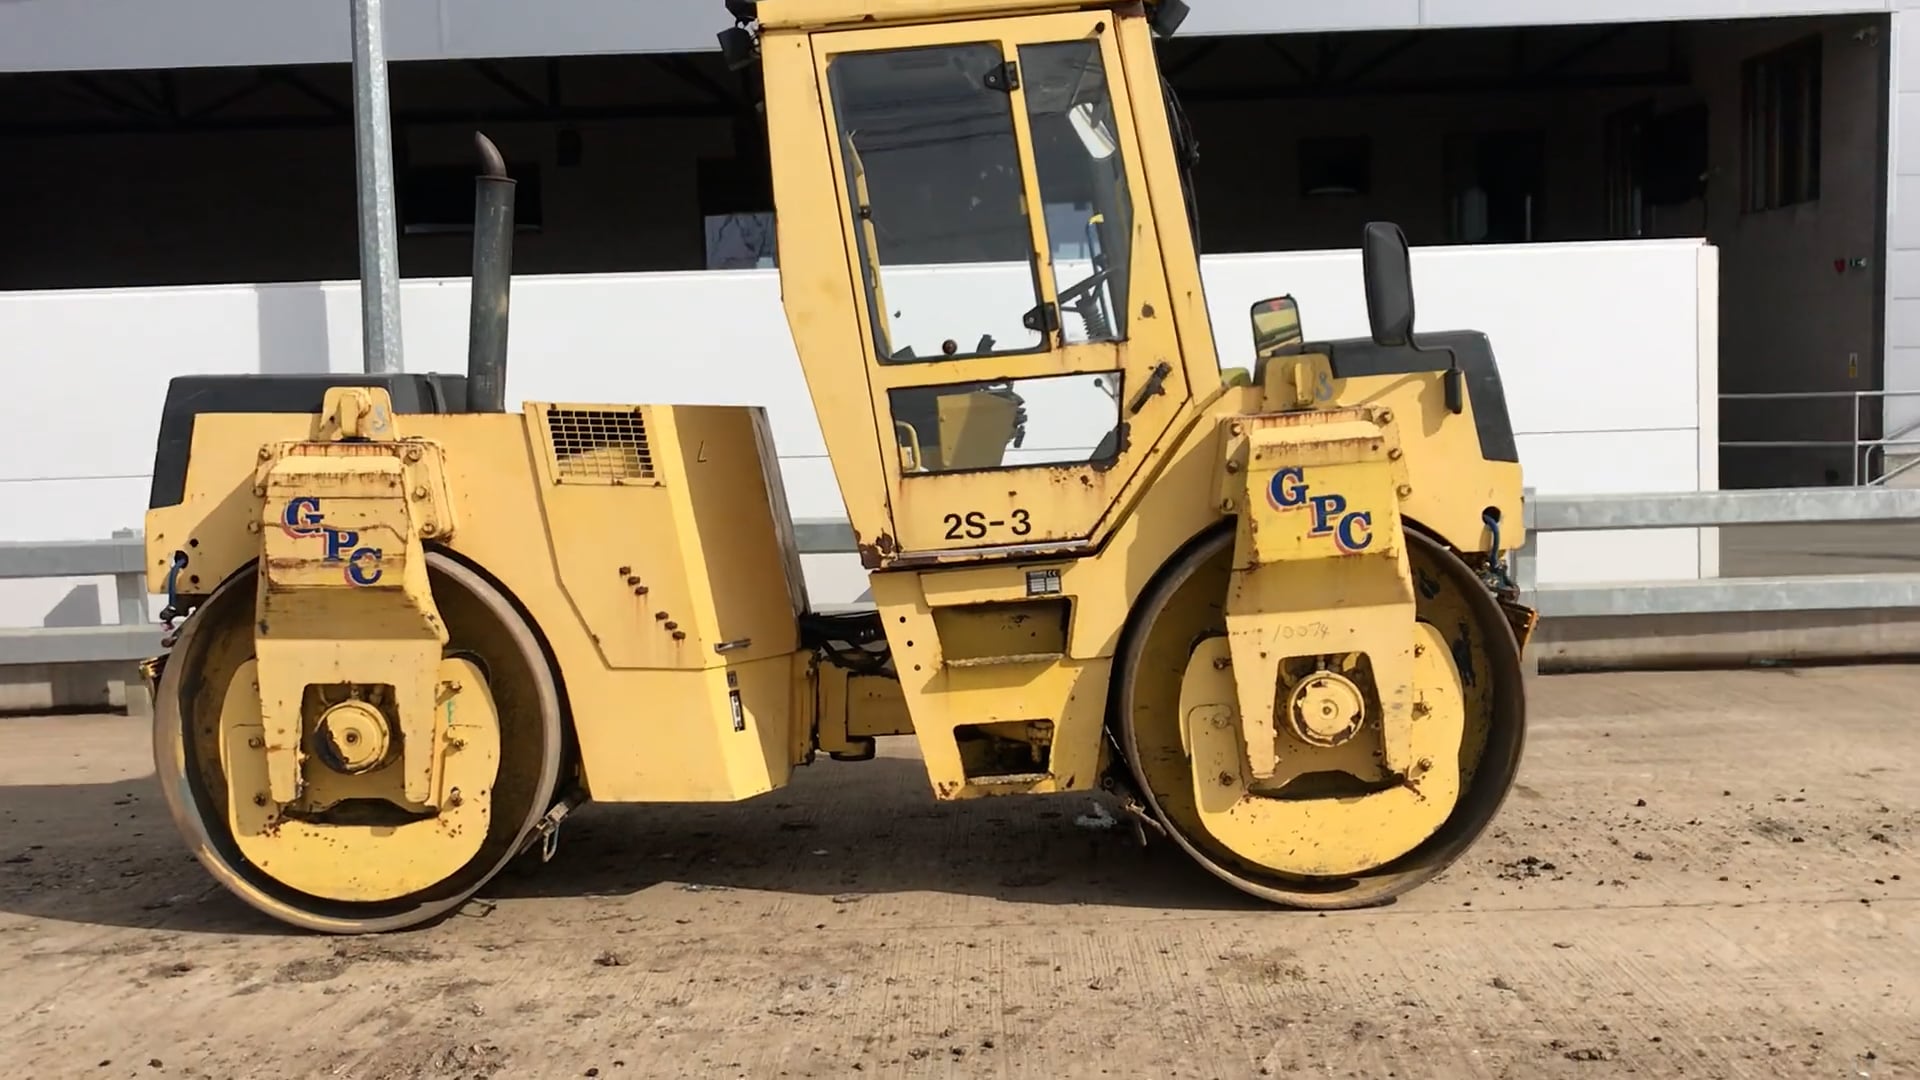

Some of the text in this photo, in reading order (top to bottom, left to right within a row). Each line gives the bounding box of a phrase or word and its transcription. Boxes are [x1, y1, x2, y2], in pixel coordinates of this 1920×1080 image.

[281, 496, 383, 588] GPC
[944, 508, 1031, 540] 2S-3
[1266, 465, 1373, 555] GPC
